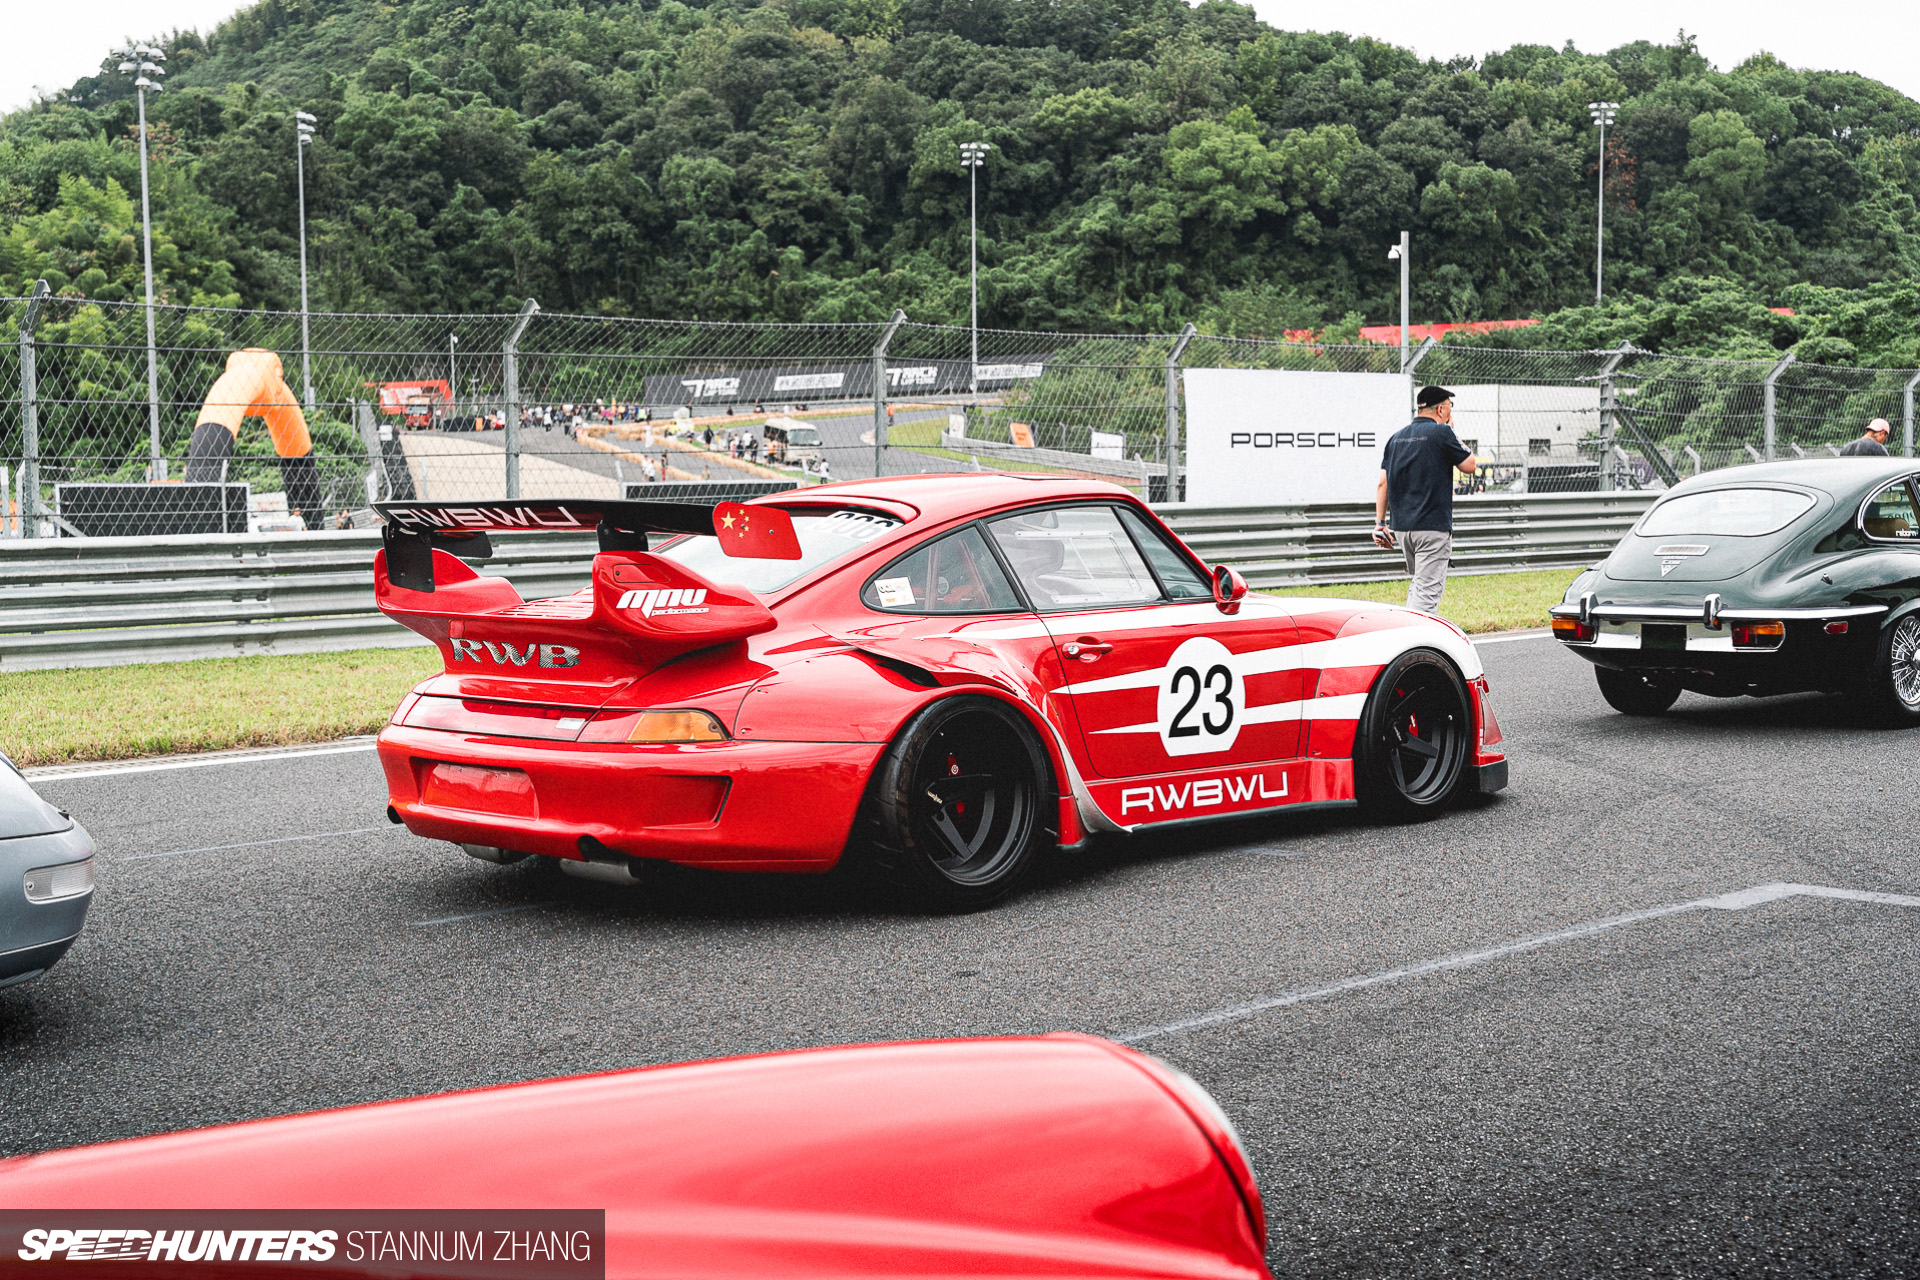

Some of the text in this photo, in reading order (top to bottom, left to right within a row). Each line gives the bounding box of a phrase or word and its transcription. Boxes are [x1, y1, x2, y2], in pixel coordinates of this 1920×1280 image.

[1231, 433, 1376, 448] PORSCHE
[387, 506, 582, 527] RWBWU
[448, 637, 581, 668] RWB
[1168, 664, 1234, 738] 23
[1121, 771, 1289, 816] RWBWU
